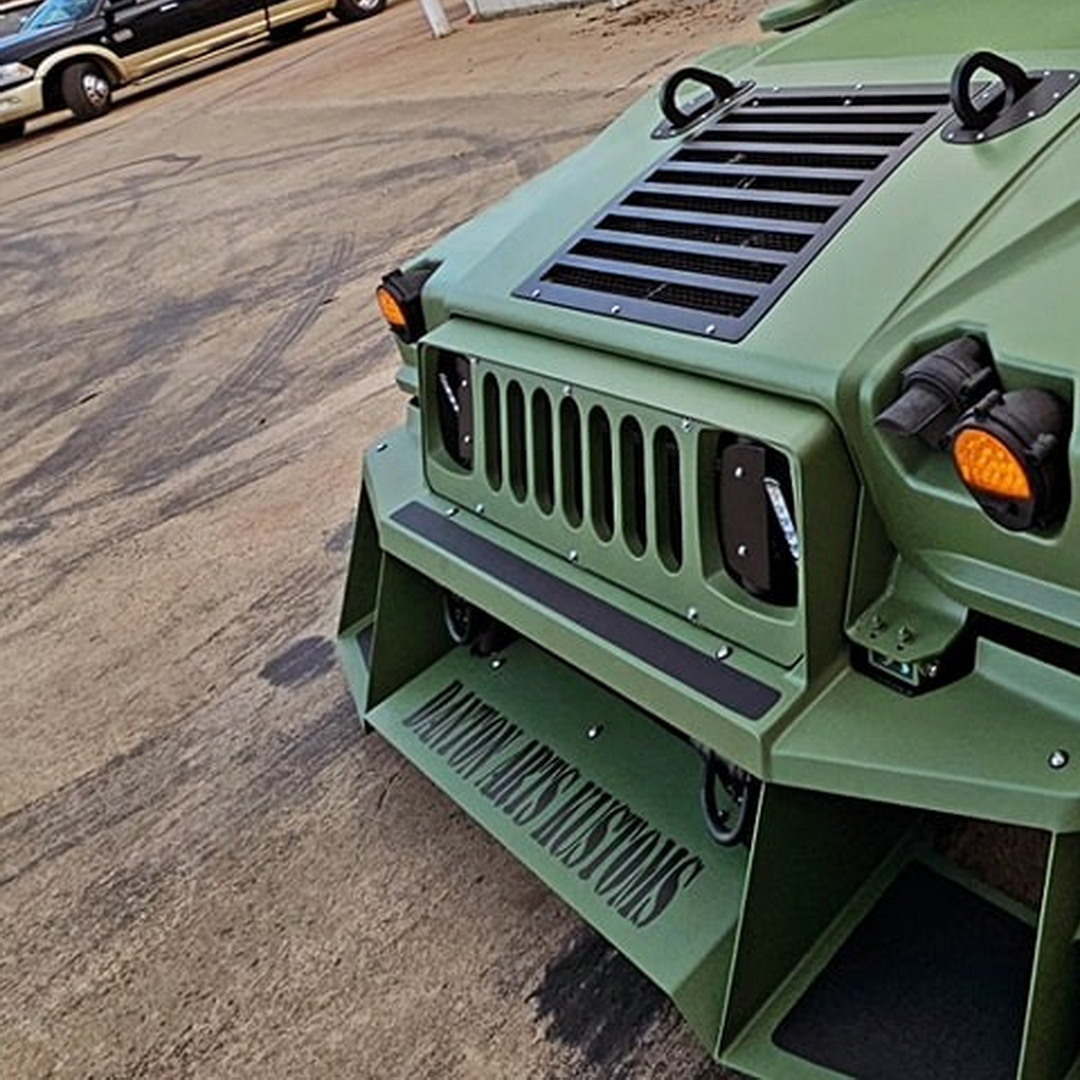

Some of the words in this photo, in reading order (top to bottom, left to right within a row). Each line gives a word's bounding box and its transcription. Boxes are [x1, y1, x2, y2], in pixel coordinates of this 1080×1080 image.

[402, 679, 524, 780] DANTON
[474, 739, 581, 827] ARTS
[530, 780, 706, 929] KUSTOMS
